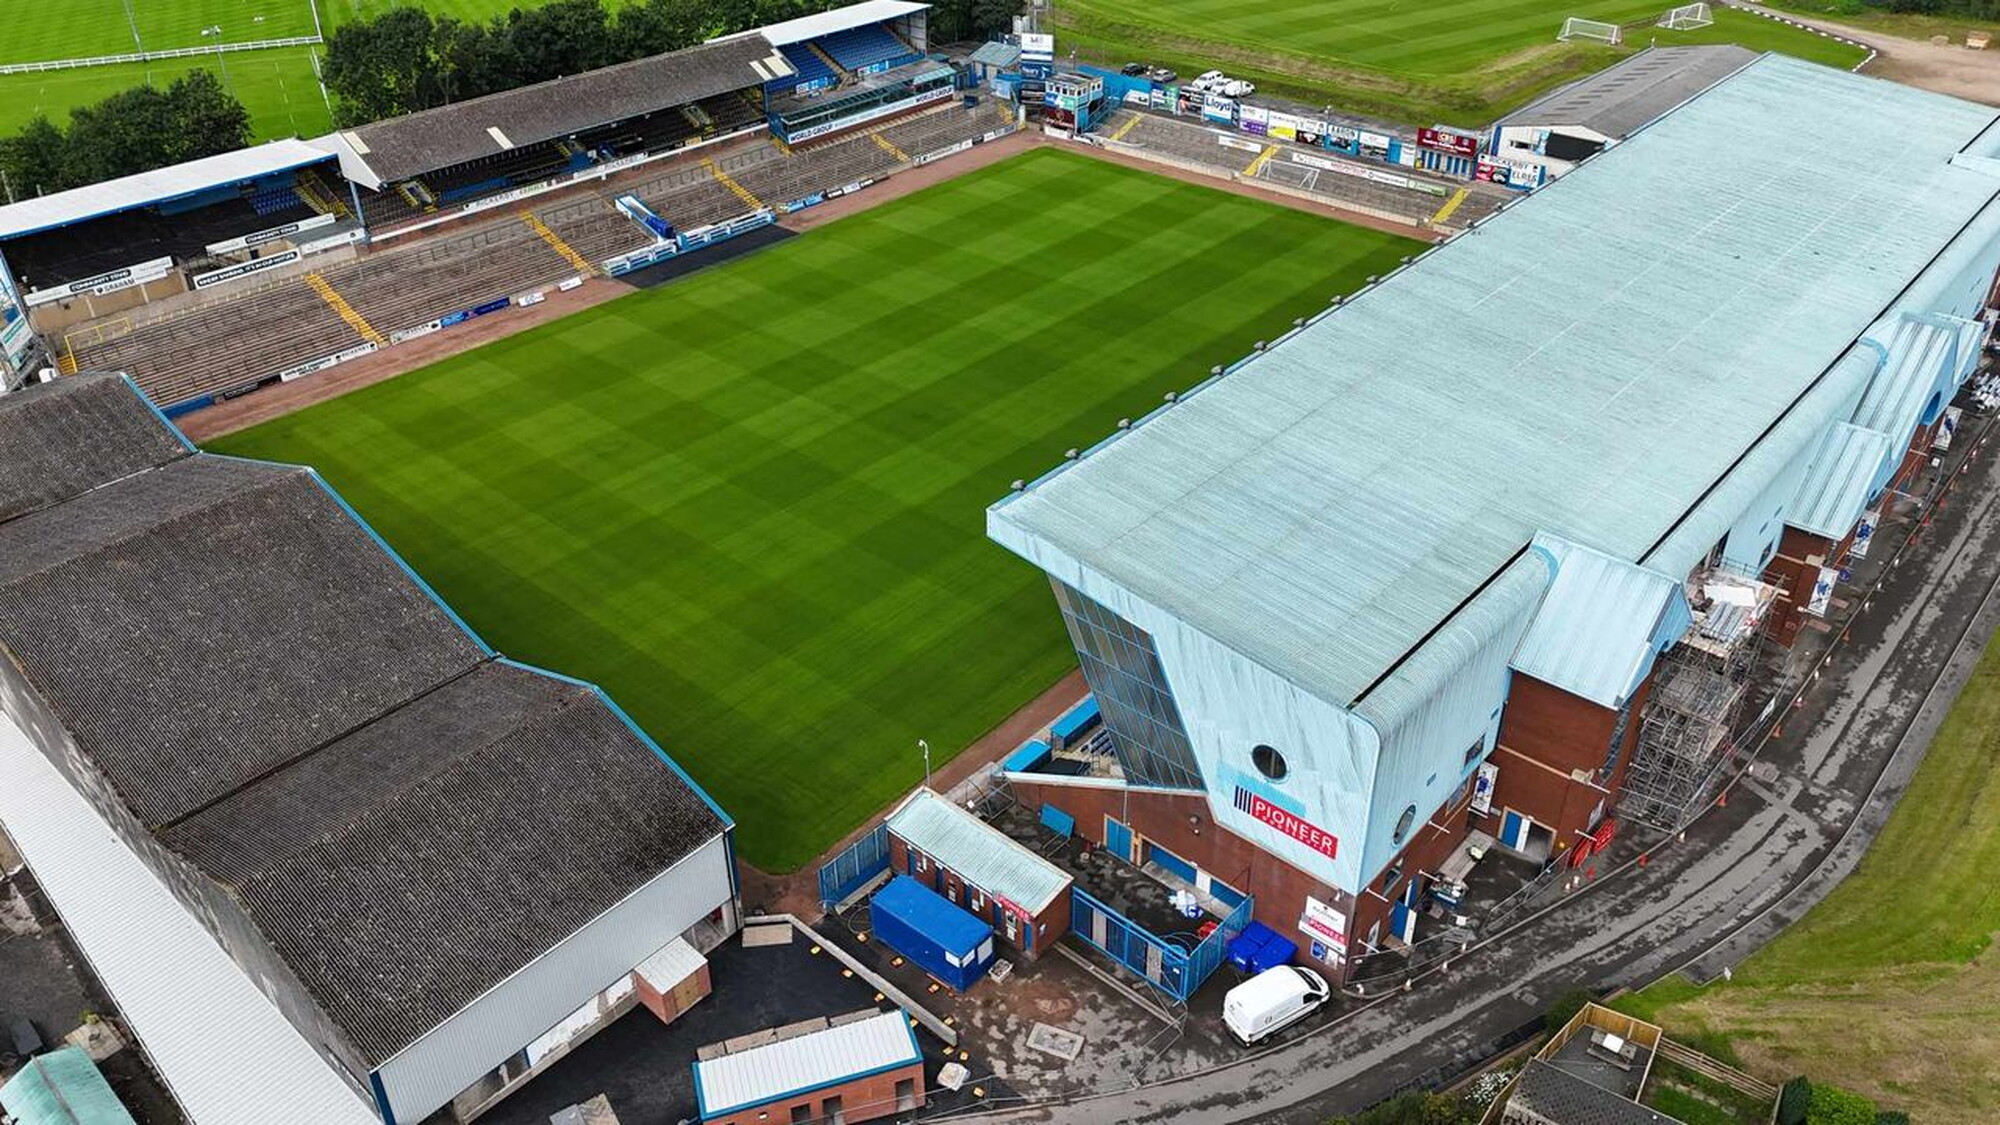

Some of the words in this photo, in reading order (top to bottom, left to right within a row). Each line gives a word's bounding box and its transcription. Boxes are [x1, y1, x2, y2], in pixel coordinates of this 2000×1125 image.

[916, 93, 935, 103] WORLD
[936, 87, 953, 97] GROUP
[1205, 97, 1231, 111] Lloyd
[790, 129, 813, 142] WORLD
[813, 123, 833, 136] GROUP
[1255, 800, 1333, 850] PIONEER
[1309, 919, 1346, 945] PIONEER
